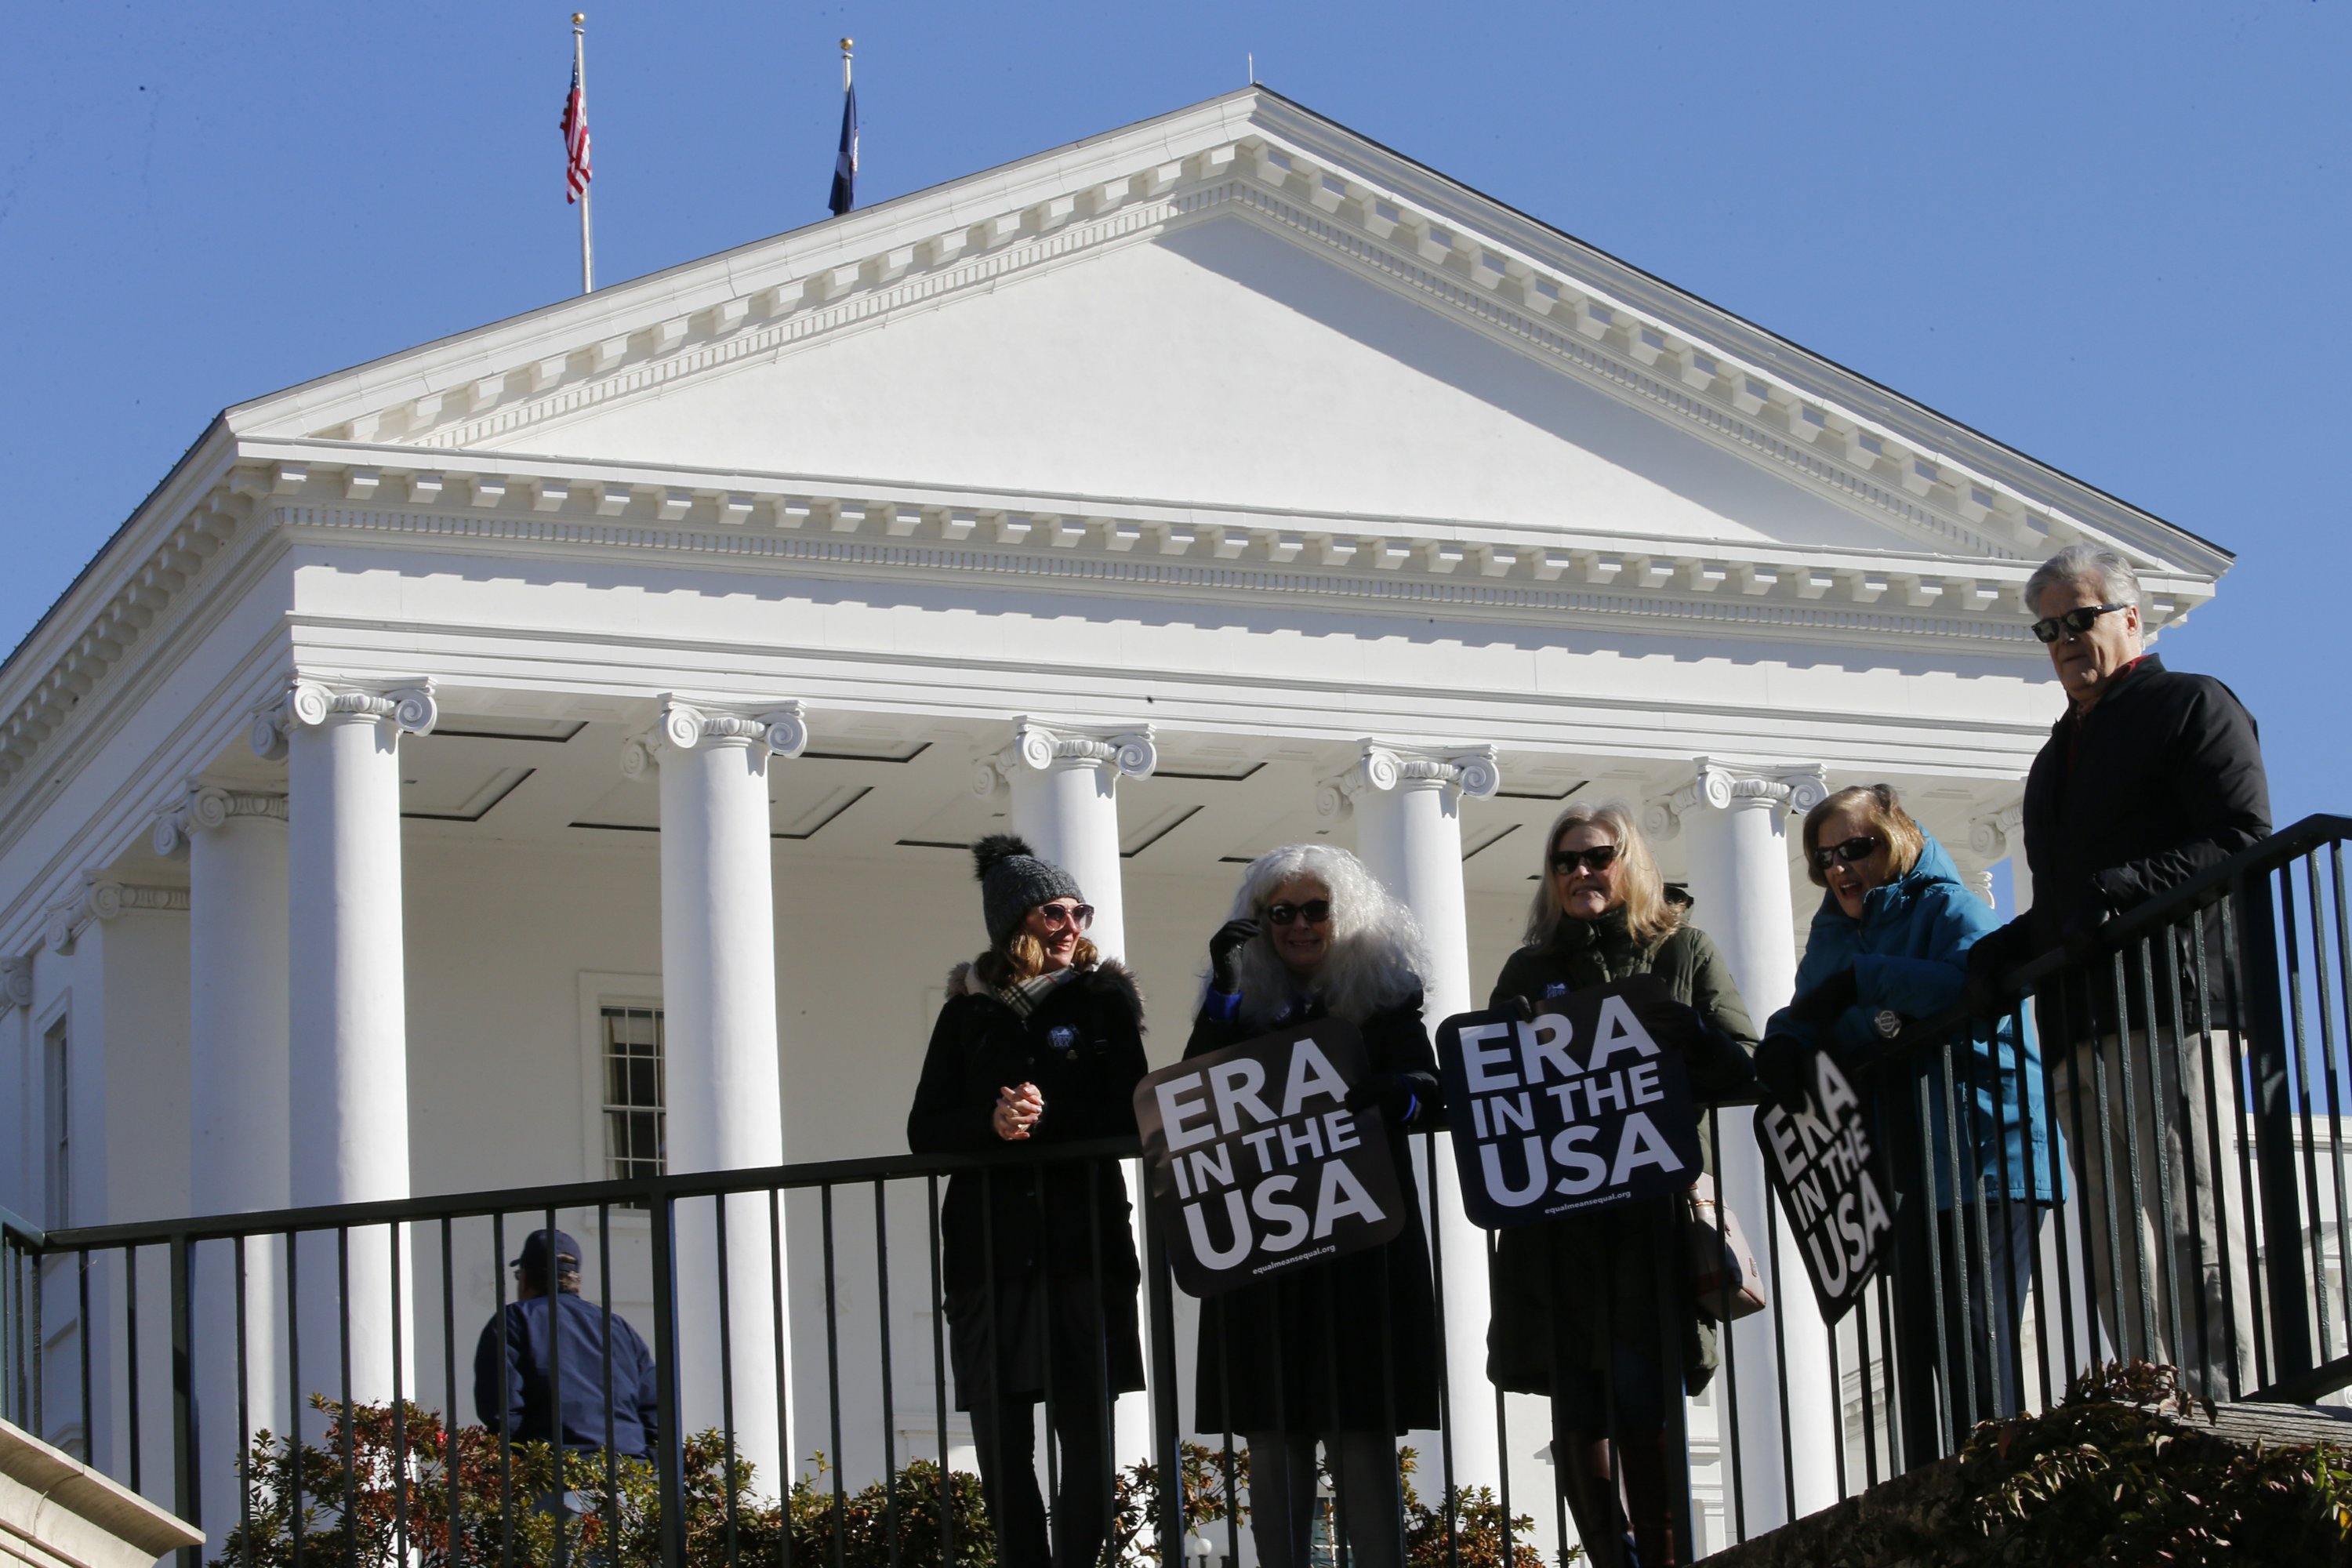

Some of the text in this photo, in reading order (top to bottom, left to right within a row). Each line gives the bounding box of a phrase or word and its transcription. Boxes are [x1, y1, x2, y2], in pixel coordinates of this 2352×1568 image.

[1458, 995, 1661, 1093] ERA
[1155, 1038, 1350, 1152] ERA
[1471, 1062, 1664, 1138] IN THE
[1171, 1109, 1360, 1199] IN THE
[1479, 1112, 1685, 1207] USA
[1791, 1113, 1871, 1231] IN THE
[1183, 1159, 1386, 1270] USA
[1544, 1191, 1631, 1214] equalmeansequal.org
[1808, 1170, 1892, 1298] USA
[1253, 1244, 1336, 1274] equalmeansequal.org
